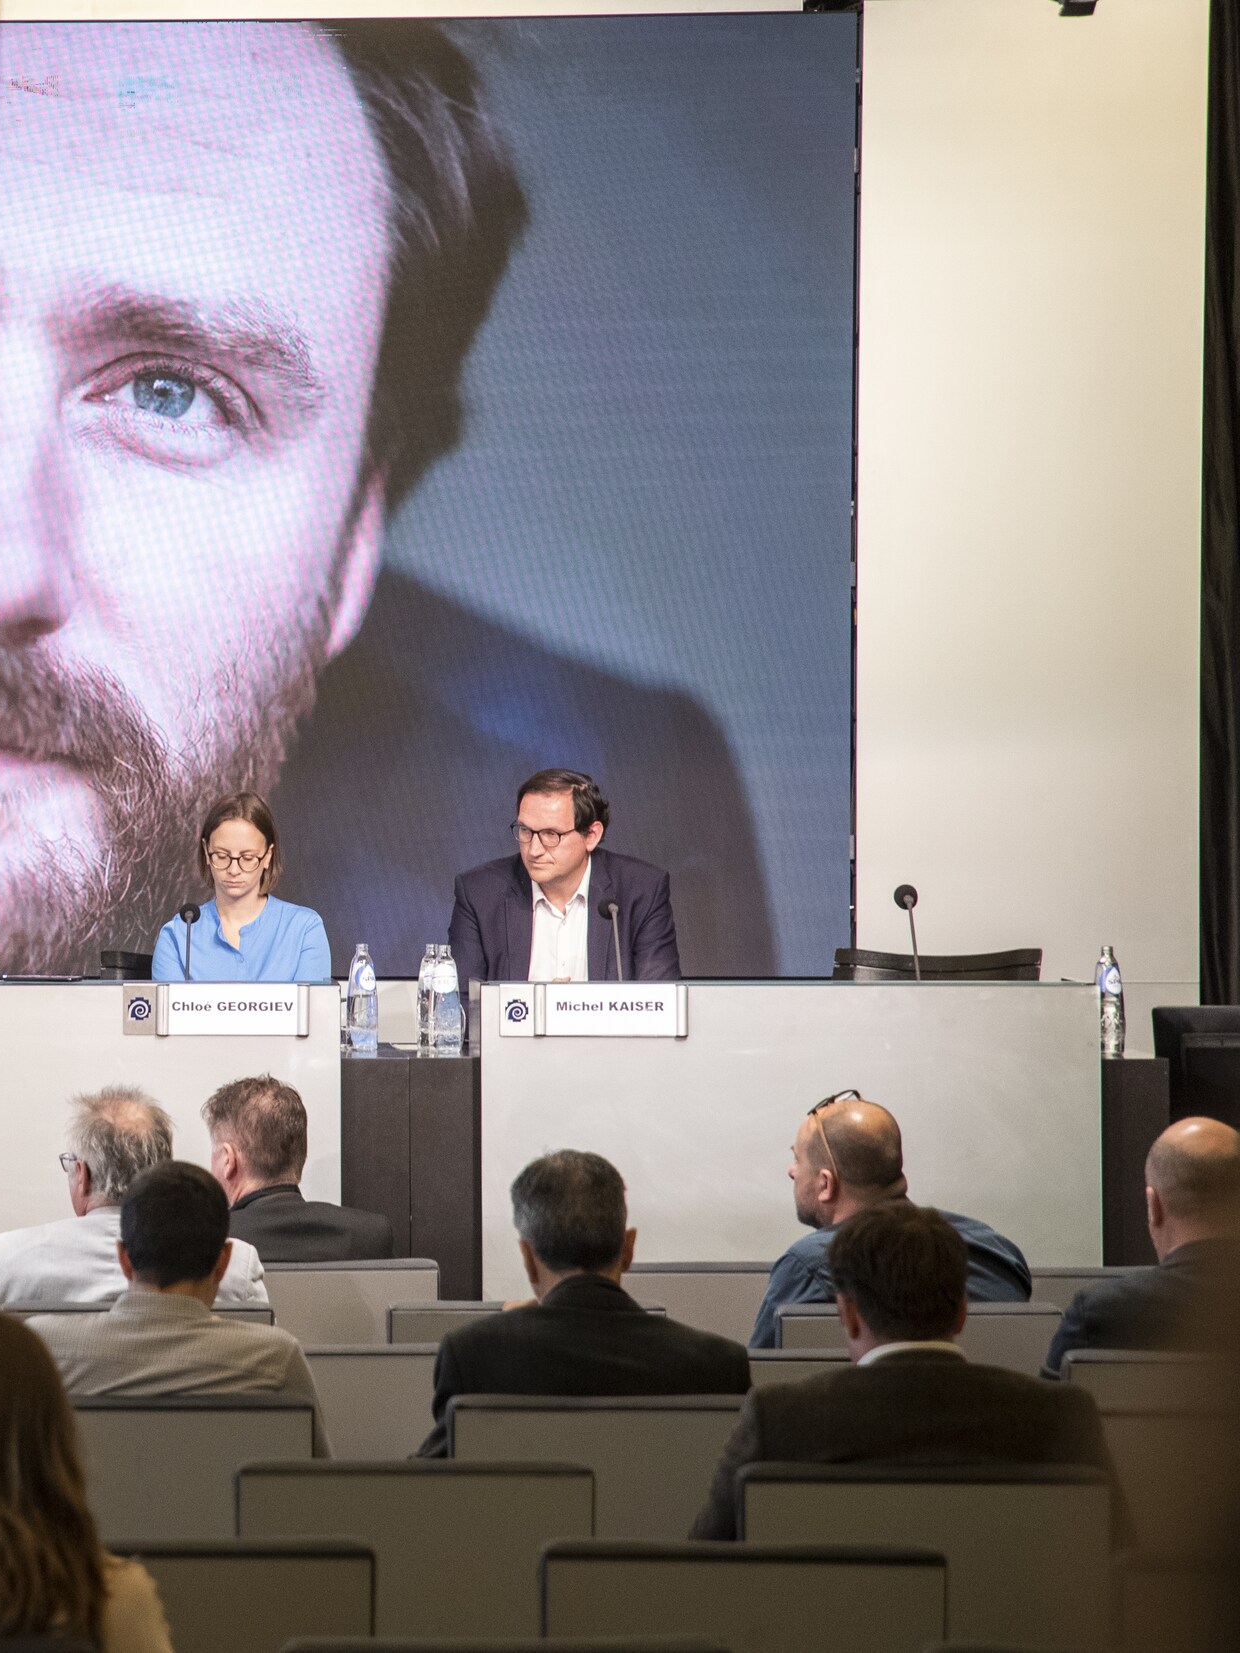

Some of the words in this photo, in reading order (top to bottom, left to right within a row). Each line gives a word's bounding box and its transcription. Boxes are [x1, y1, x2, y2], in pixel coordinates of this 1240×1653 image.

[171, 1001, 212, 1012] Chloé
[216, 1001, 294, 1012] GEORGIEV
[556, 1001, 603, 1012] Michel
[608, 1001, 664, 1012] KAISER
